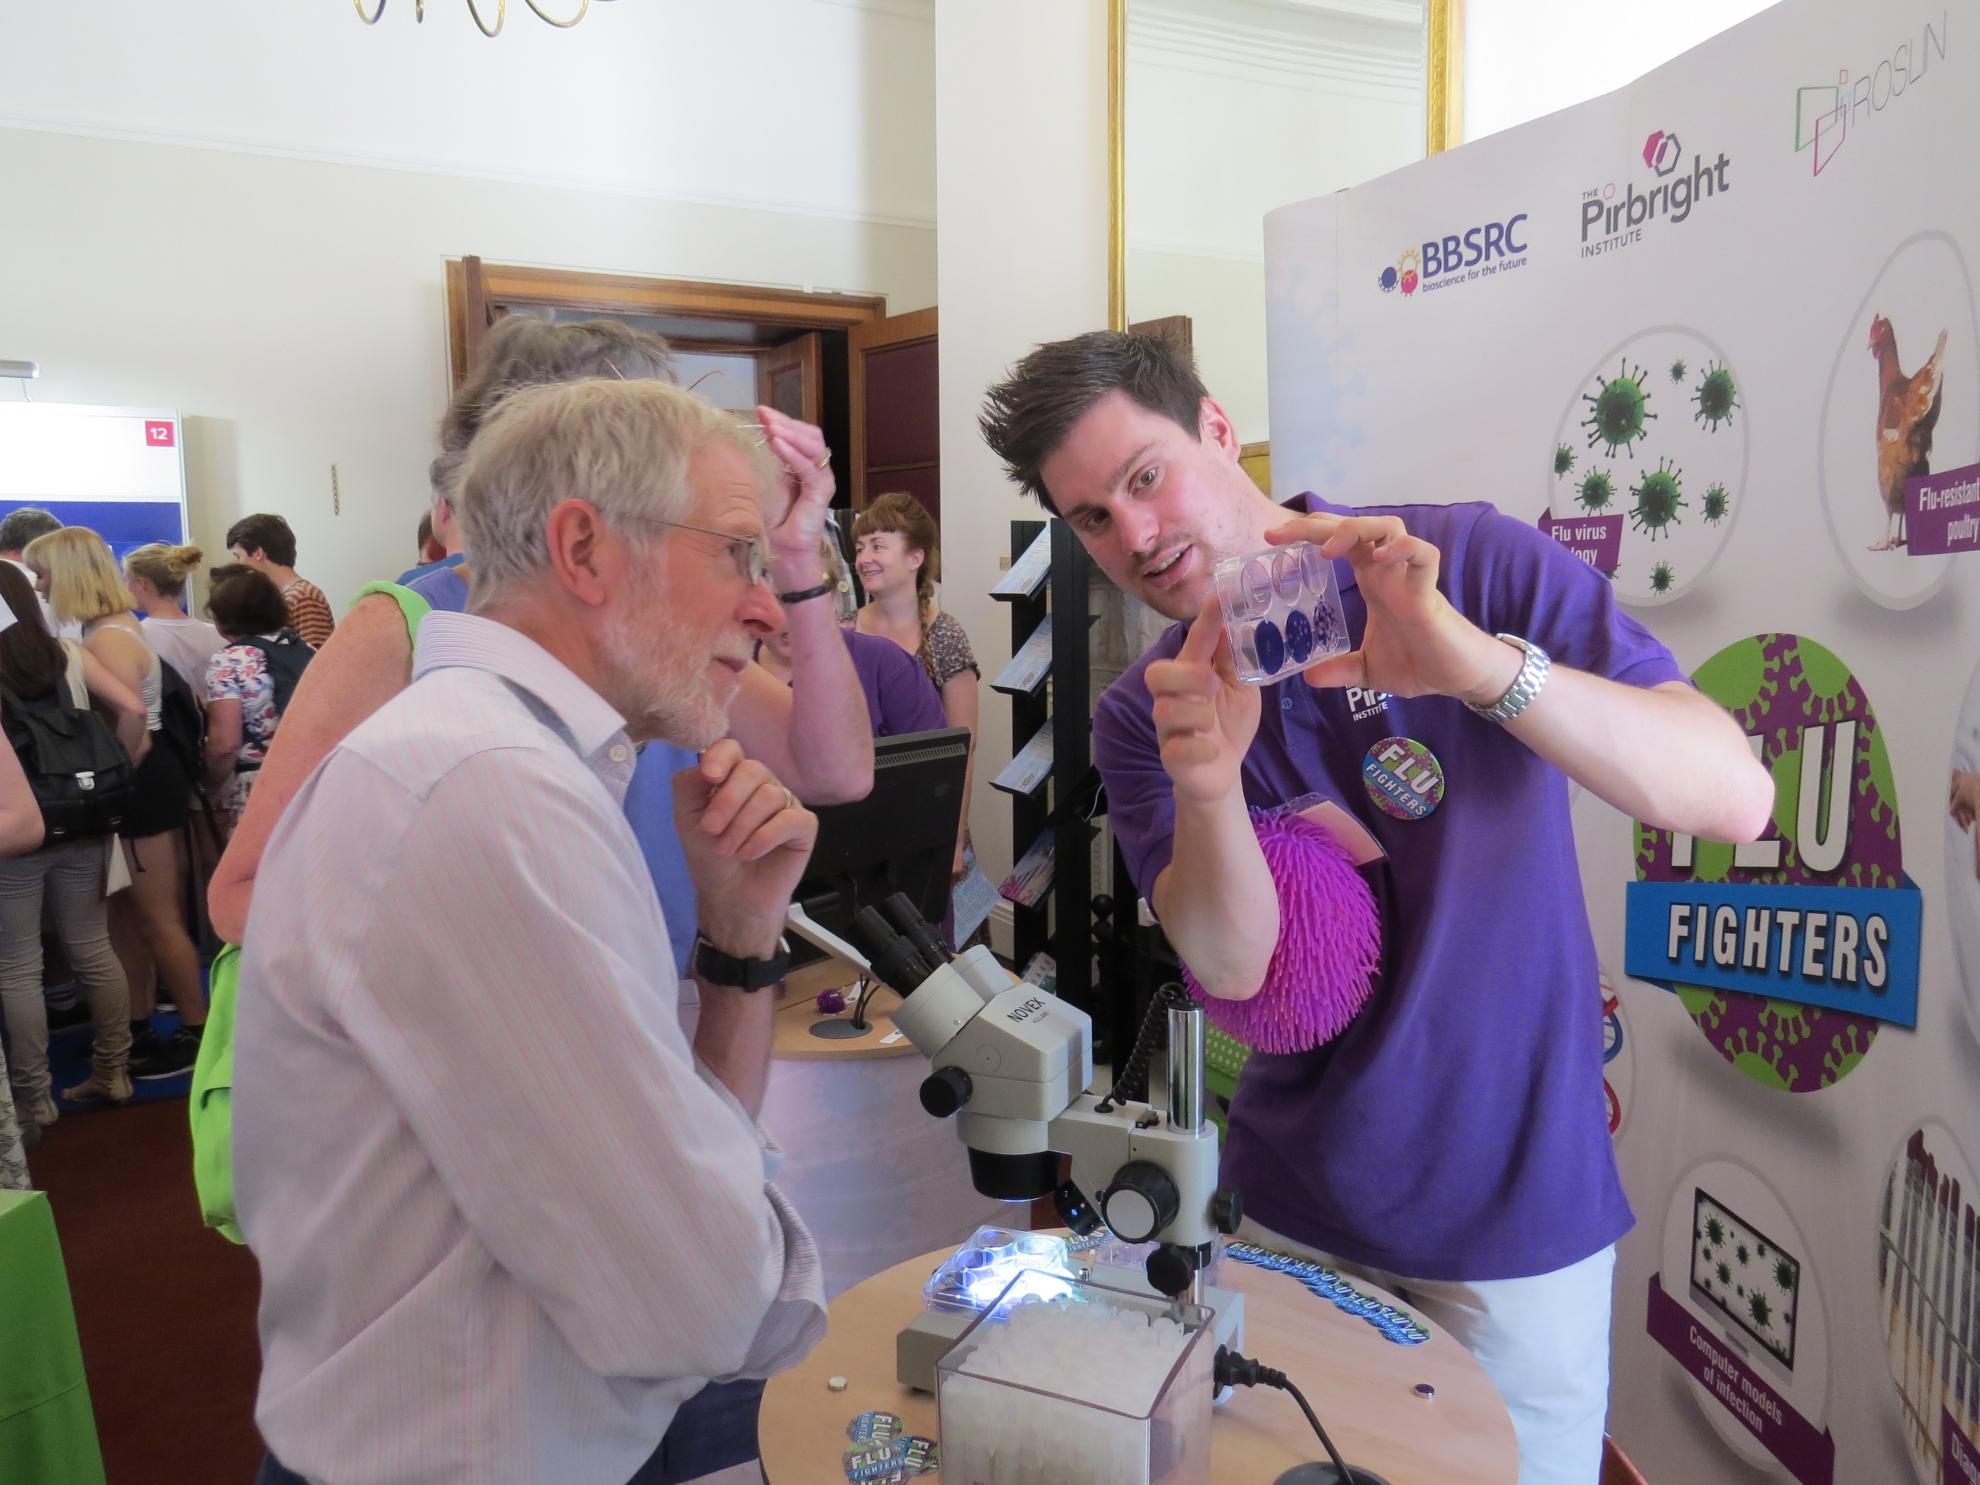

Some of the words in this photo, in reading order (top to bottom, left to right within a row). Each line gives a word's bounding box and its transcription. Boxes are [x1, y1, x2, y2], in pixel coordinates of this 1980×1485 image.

[1851, 9, 1948, 128] ROSLIN
[1581, 188, 1599, 200] THE
[1581, 152, 1731, 242] Pirbright
[1422, 213, 1528, 279] BBSRC
[1581, 228, 1643, 259] INSTITUTE
[1422, 274, 1466, 293] bioscience
[1467, 268, 1480, 283] for
[1481, 264, 1497, 277] the
[1499, 256, 1528, 275] future
[150, 427, 169, 440] 12
[1919, 476, 1980, 512] Flu-resistant
[1551, 525, 1571, 542] Flu
[1575, 523, 1607, 541] virus
[1947, 513, 1980, 547] poultry
[1377, 743, 1440, 794] FLU
[1365, 763, 1426, 815] FIGHTERS
[1667, 902, 1889, 988] FIGHTERS
[1006, 996, 1046, 1023] NOVEX
[1230, 1242, 1265, 1255] FLU
[1269, 1253, 1294, 1264] LU
[1295, 1261, 1321, 1272] LU
[1382, 1306, 1410, 1324] FLU
[1400, 1327, 1427, 1340] LU
[1689, 1325, 1740, 1384] Computer
[1741, 1376, 1783, 1426] models
[1703, 1365, 1715, 1386] of
[1716, 1373, 1763, 1433] infection
[871, 1414, 893, 1440] FLU
[851, 1447, 891, 1470] FLU
[904, 1439, 930, 1468] FLU
